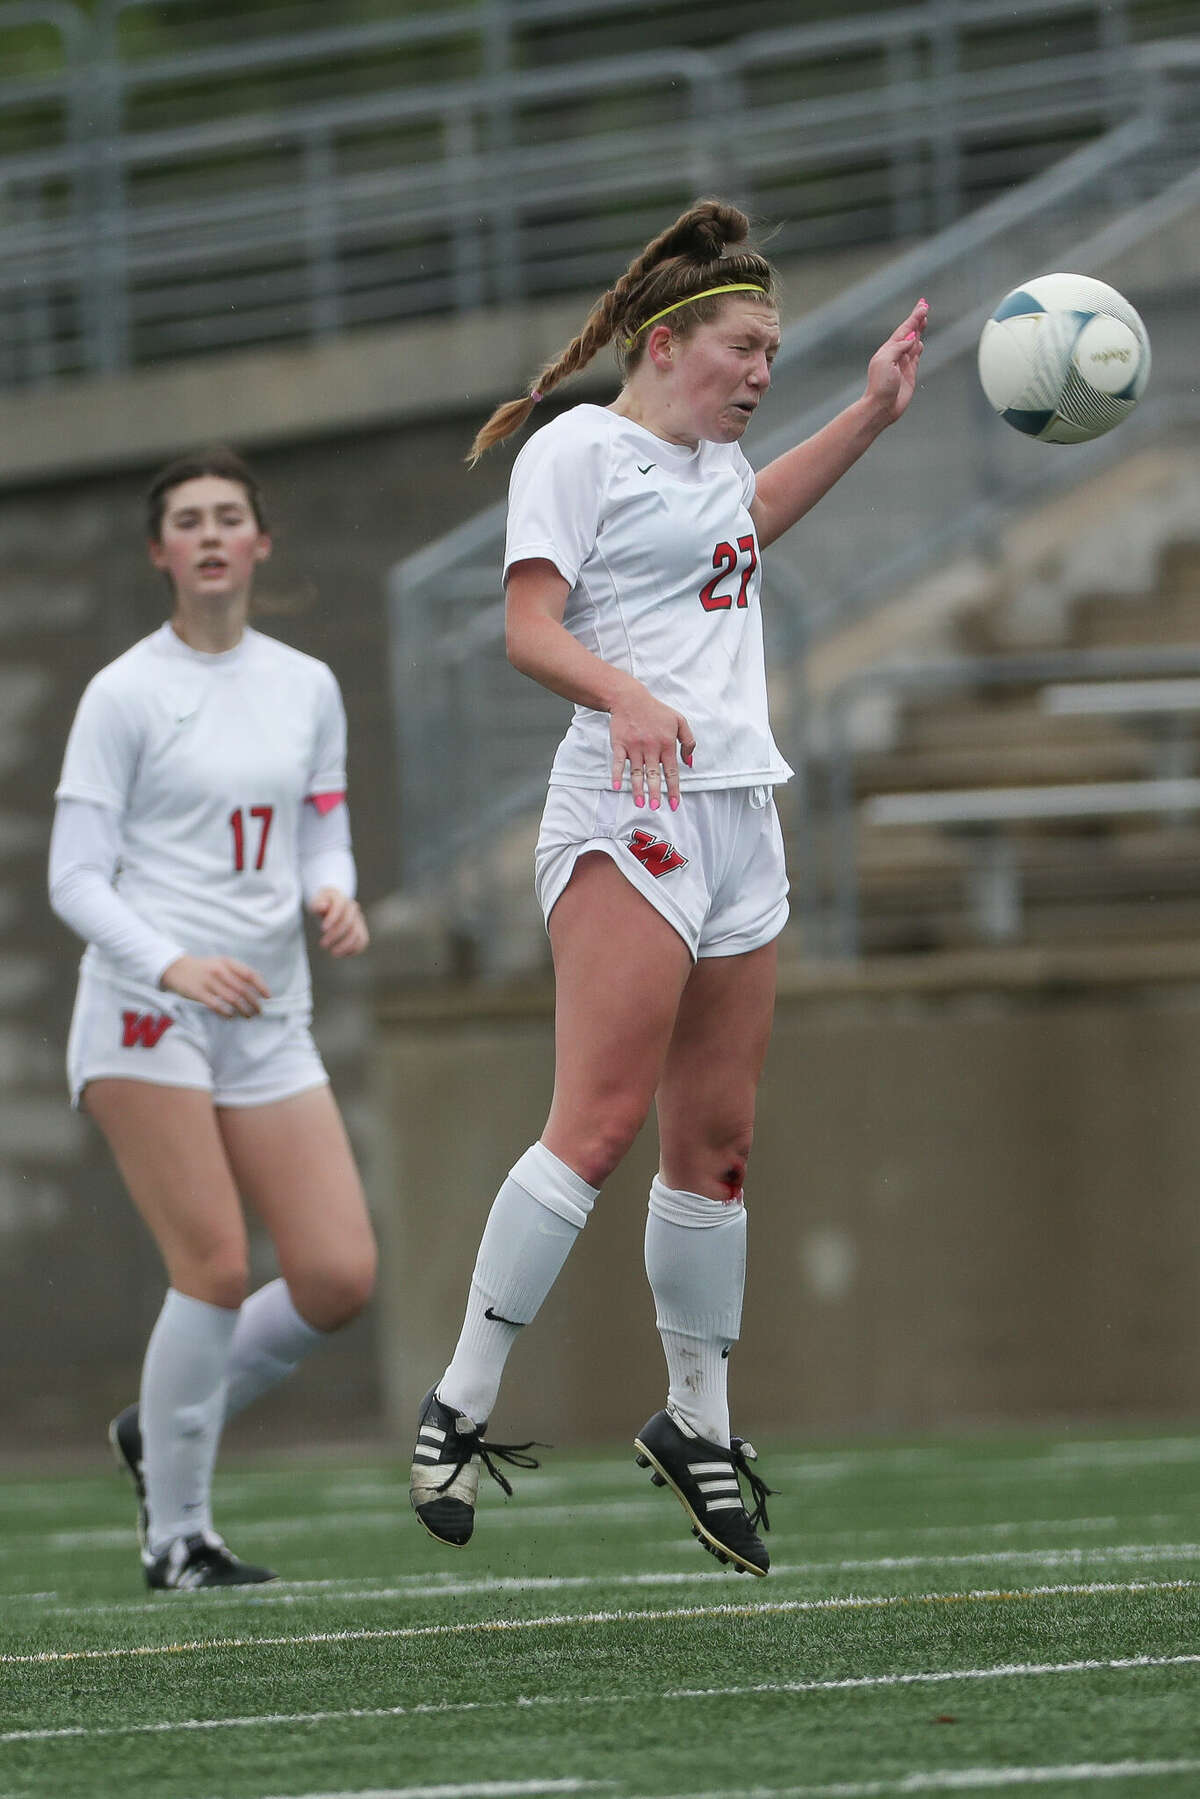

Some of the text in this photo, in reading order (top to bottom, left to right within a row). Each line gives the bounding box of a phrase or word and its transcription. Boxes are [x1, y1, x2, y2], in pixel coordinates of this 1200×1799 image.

[699, 533, 757, 612] 27
[230, 806, 273, 871] 17
[627, 828, 689, 879] W
[122, 1011, 175, 1048] W
